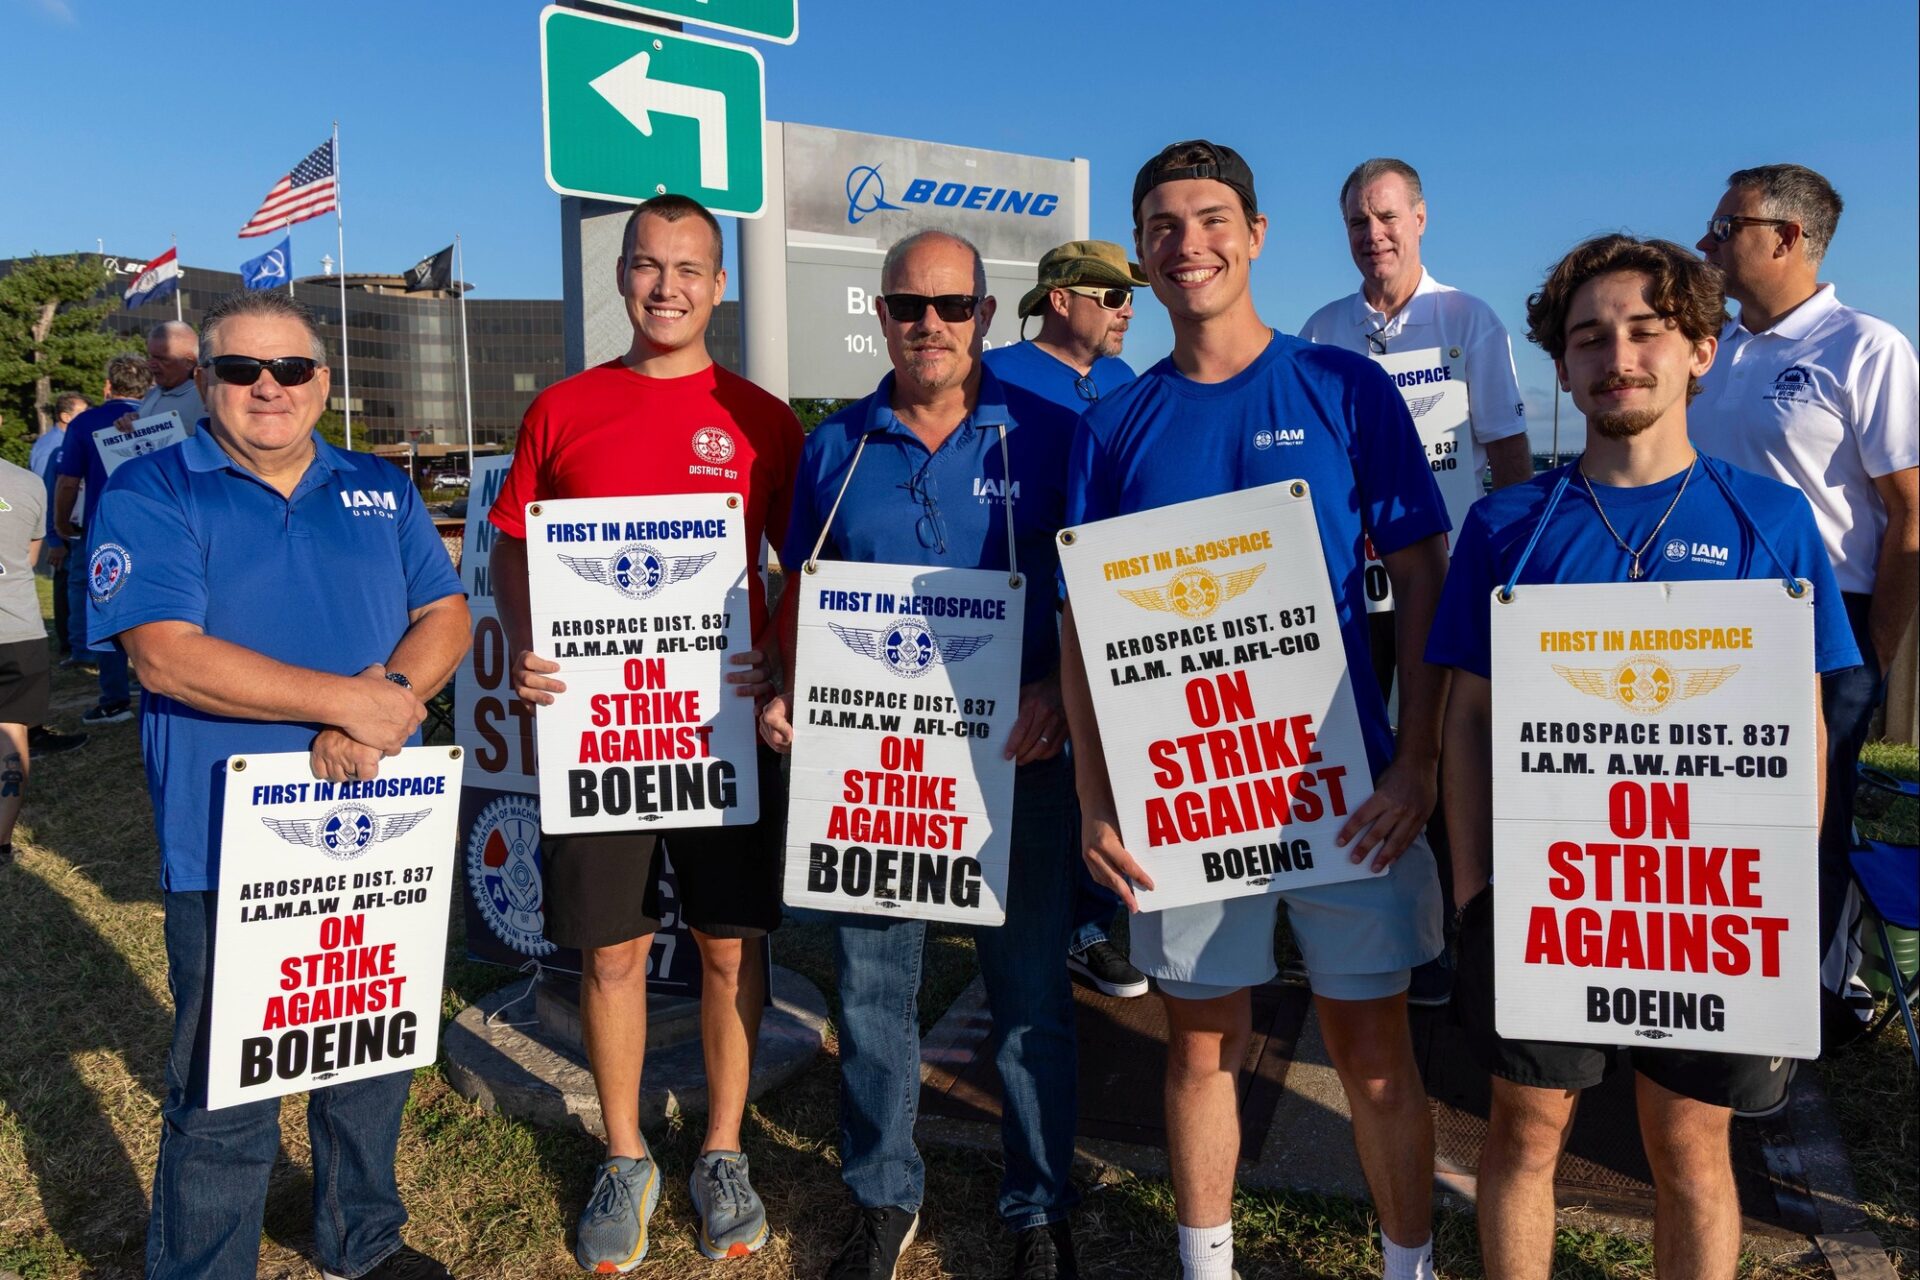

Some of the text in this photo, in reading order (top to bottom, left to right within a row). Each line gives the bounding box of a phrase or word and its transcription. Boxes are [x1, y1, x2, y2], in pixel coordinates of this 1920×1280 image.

[902, 179, 1058, 216] BOEING
[845, 334, 878, 356] 101,
[103, 421, 174, 446] FIRST IN AEROSPACE
[1275, 429, 1304, 441] IAM
[1435, 441, 1458, 455] 837
[689, 465, 738, 479] DISTRICT 837
[973, 478, 1020, 498] IAM
[340, 490, 397, 510] IAM
[353, 509, 393, 519] UNION
[547, 519, 726, 542] FIRST IN AEROSPACE
[1103, 530, 1272, 581] FIRST IN AEROSPACE
[1692, 542, 1728, 560] IAM
[820, 590, 1006, 620] FIRST IN AEROSPACE
[552, 613, 731, 636] AEROSPACE DIST. 837
[1106, 605, 1316, 661] AEROSPACE DIST. 837
[1540, 627, 1753, 652] FIRST IN AEROSPACE
[555, 635, 728, 658] I.A.M.A.W AFL-CIO
[1111, 632, 1320, 686] I.A.M. A.W. AFL-CIO
[624, 658, 666, 691] ON
[591, 691, 700, 727] STRIKE
[808, 686, 995, 716] AEROSPACE DIST. 837
[1185, 670, 1256, 728] ON
[809, 709, 900, 731] I.A.M.A.W
[1520, 722, 1790, 746] AEROSPACE DIST. 837
[579, 726, 713, 763] AGAINST
[881, 736, 924, 772] ON
[1148, 714, 1322, 790] STRIKE
[1521, 752, 1788, 778] I.A.M. A.W. AFL-CIO
[252, 776, 445, 805] FIRST IN AEROSPACE
[568, 760, 737, 817] BOEING
[844, 769, 956, 811] STRIKE
[1145, 766, 1348, 847] AGAINST
[499, 808, 508, 819] OF
[827, 805, 968, 850] AGAINST
[1608, 781, 1690, 840] ON
[475, 815, 498, 871] ASSOCIATION
[1202, 839, 1314, 882] BOEING
[240, 866, 433, 900] AEROSPACE DIST. 837
[807, 843, 981, 908] BOEING
[1548, 841, 1762, 908] STRIKE
[241, 888, 427, 923] I.A.M.A.W AFL-CIO
[477, 875, 520, 940] INTERNATIONAL
[320, 914, 364, 950] ON
[1524, 906, 1789, 978] AGAINST
[280, 943, 396, 991] STRIKE
[263, 976, 406, 1030] AGAINST
[1586, 986, 1725, 1032] BOEING
[240, 1010, 417, 1088] BOEING
